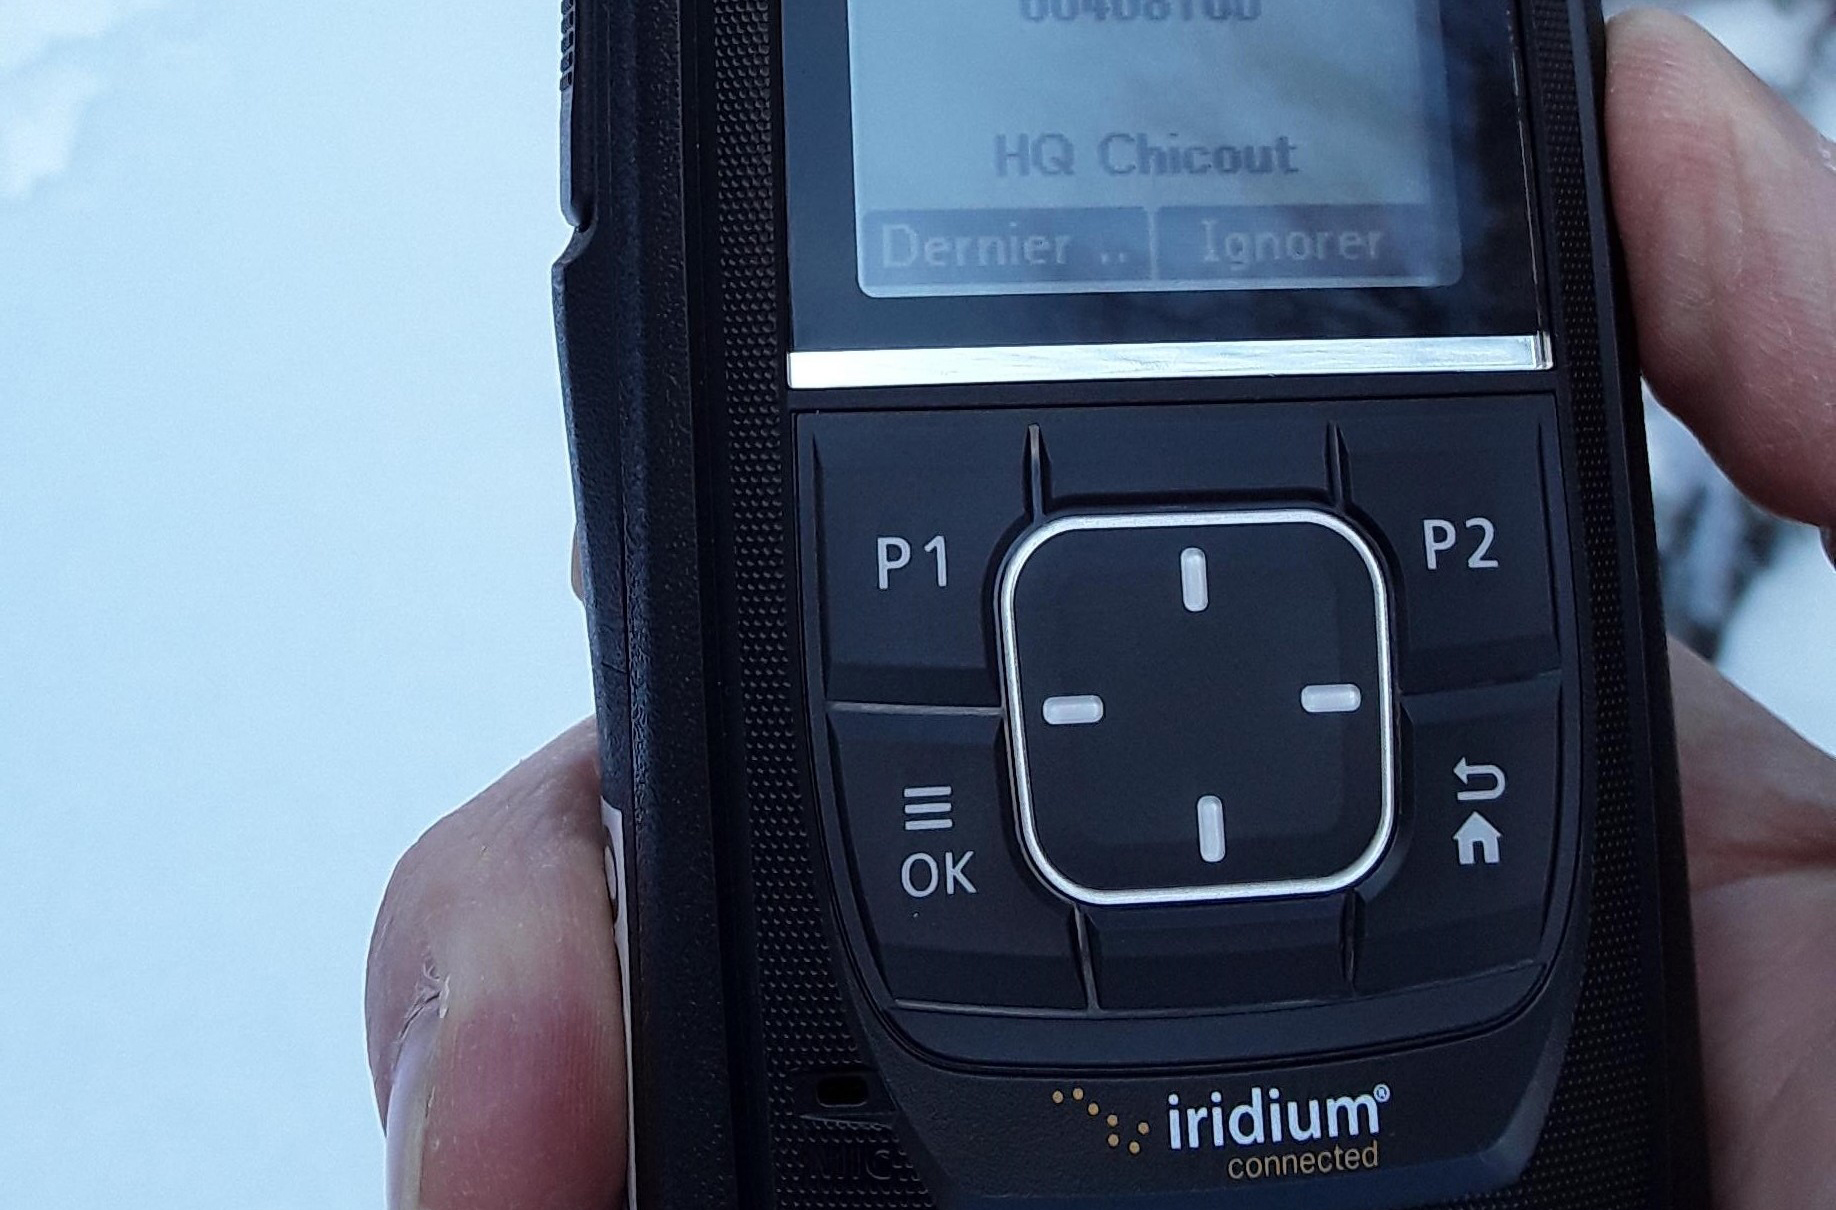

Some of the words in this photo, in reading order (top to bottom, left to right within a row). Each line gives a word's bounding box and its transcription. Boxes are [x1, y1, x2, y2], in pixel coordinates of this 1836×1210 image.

[994, 133, 1075, 180] HQ
[1099, 132, 1300, 178] Chicout
[880, 222, 1073, 269] Dernier
[1200, 219, 1382, 272] Ignorer
[876, 535, 948, 590] P1
[1422, 517, 1500, 570] P2
[900, 851, 977, 898] OK
[1227, 1141, 1380, 1179] connected
